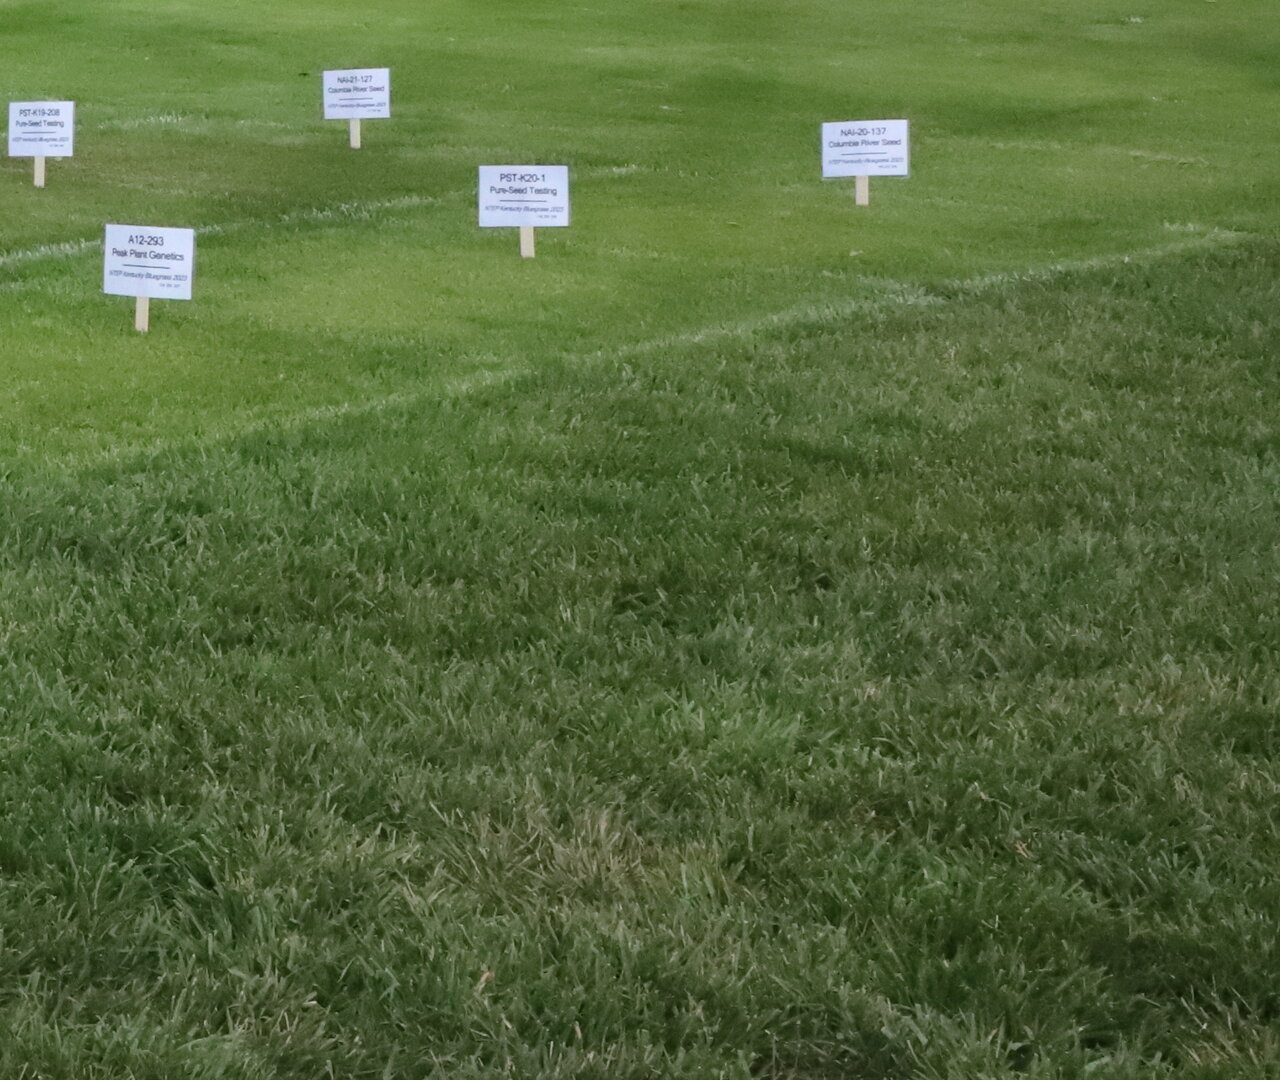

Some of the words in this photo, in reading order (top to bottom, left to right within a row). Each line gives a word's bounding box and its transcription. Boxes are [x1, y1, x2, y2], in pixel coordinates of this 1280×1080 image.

[828, 139, 860, 149] Columbia
[860, 139, 880, 147] River
[881, 138, 902, 146] Seed
[489, 186, 528, 195] Pure-Seed
[530, 186, 558, 197] Testing
[127, 234, 165, 247] A12-293
[111, 247, 128, 257] Peak
[129, 248, 148, 259] Plant
[149, 250, 185, 261] Genetics
